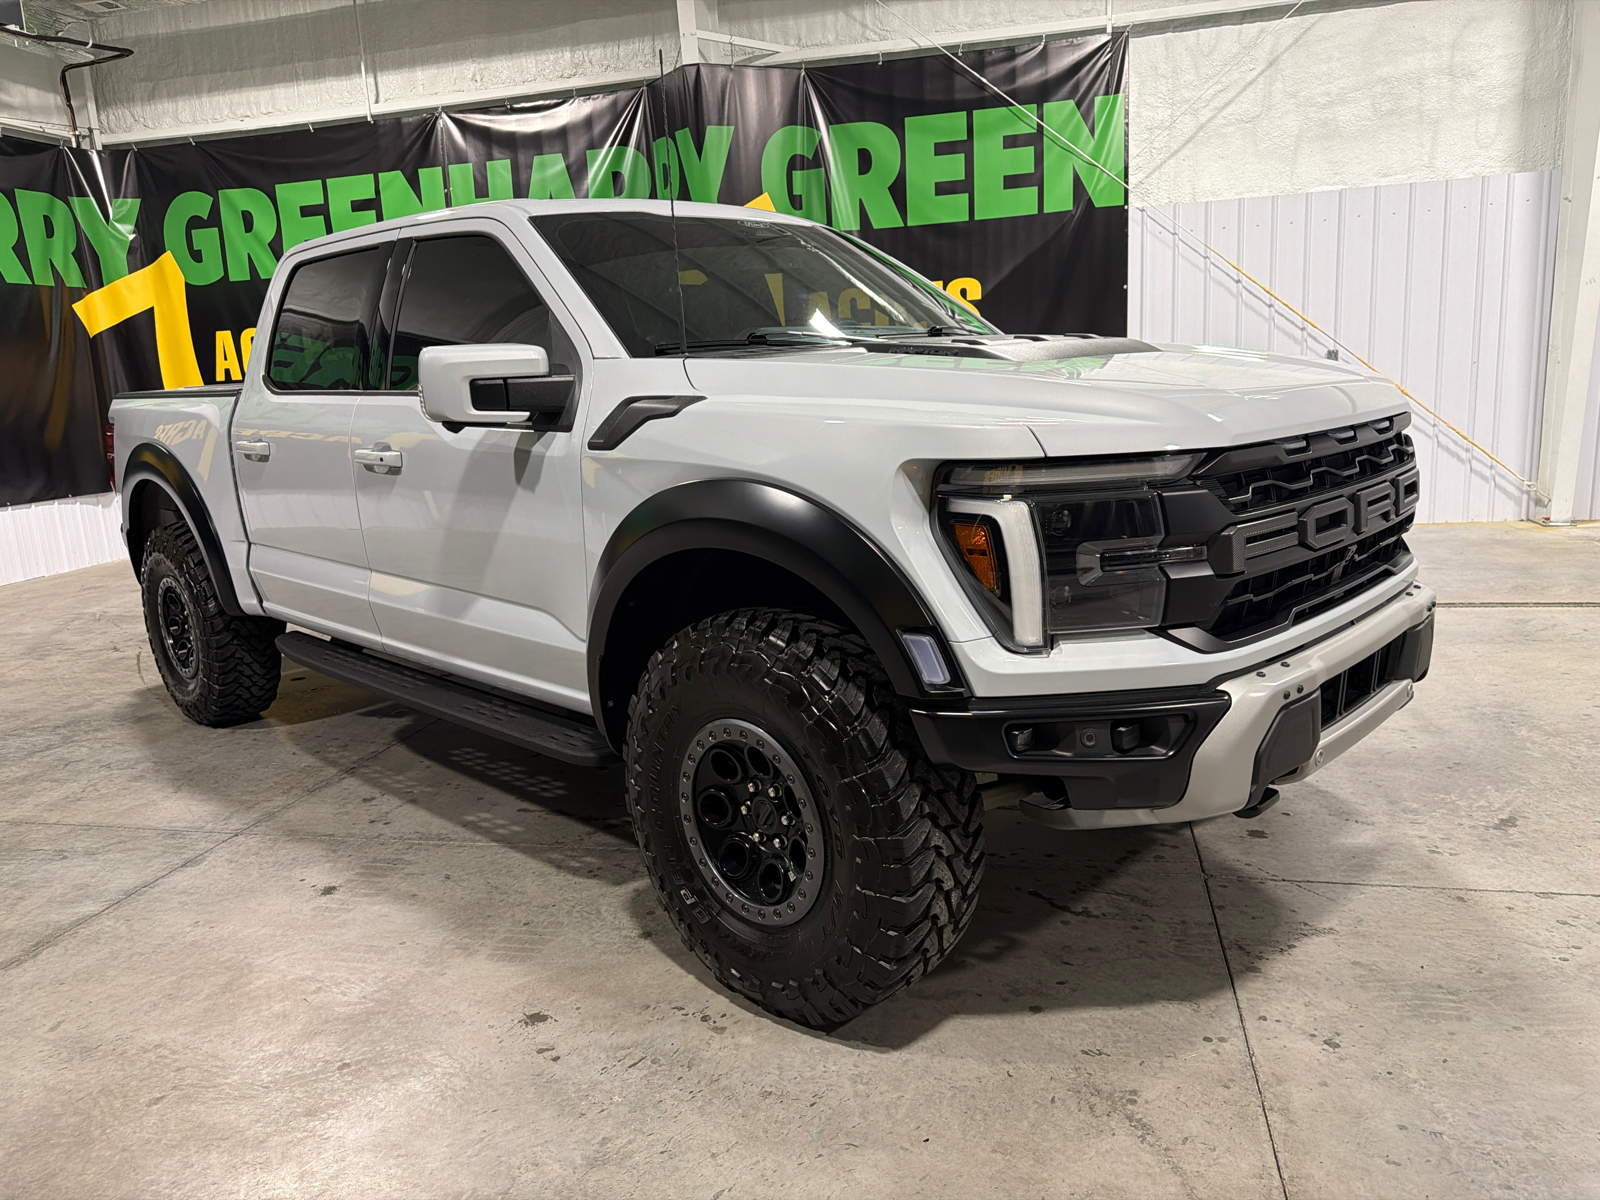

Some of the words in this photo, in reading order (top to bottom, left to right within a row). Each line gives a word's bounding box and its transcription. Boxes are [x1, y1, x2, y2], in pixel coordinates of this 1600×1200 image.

[760, 93, 1126, 231] GREEN
[72, 250, 205, 389] 7
[1212, 469, 1420, 576] FORD
